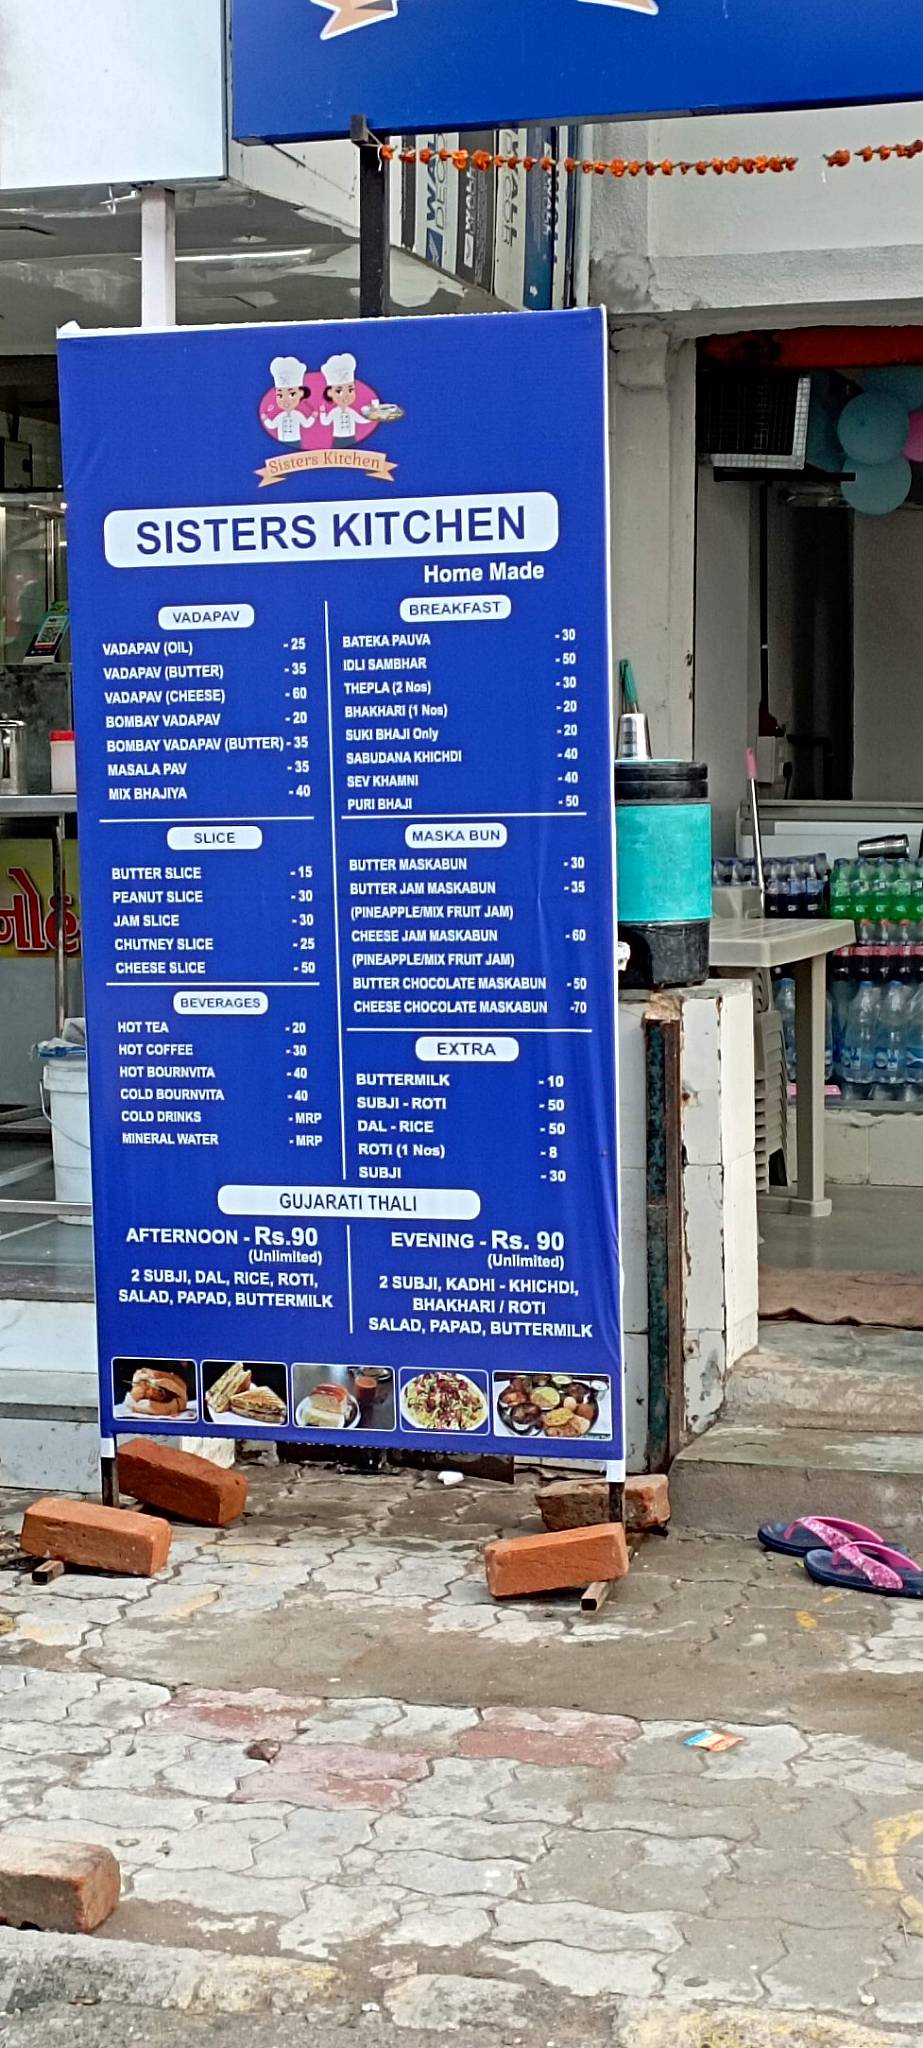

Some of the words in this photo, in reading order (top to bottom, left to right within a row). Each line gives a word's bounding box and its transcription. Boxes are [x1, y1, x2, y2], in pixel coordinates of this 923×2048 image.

[268, 455, 318, 474] Sisters
[324, 451, 380, 470] Kitchen
[137, 515, 316, 554] SISTERS
[333, 506, 524, 547] KITCHEN
[424, 565, 483, 583] Home
[490, 561, 544, 580] Made
[410, 602, 501, 615] BREAKFAST
[173, 611, 239, 623] VADAPAV
[343, 635, 390, 648] BATEKA
[392, 634, 430, 646] PAUVA
[102, 642, 160, 655] VADAPAV
[164, 641, 192, 656] (OIL)
[344, 659, 365, 671] IDLI
[368, 657, 426, 670] SAMBHAR
[104, 666, 161, 680] VADAPAV
[165, 665, 223, 680] (BUTTER)
[344, 682, 390, 694] THEPLA
[392, 682, 402, 695] (2
[406, 681, 431, 694] Nos)
[104, 691, 162, 704] VADAPAV
[166, 689, 225, 705] (CHEESE)
[345, 705, 406, 718] BHAKHARI
[408, 704, 418, 719] (1
[422, 704, 447, 718] Nos)
[106, 715, 159, 728] BOMBAY
[162, 714, 220, 726] VADAPAV
[346, 729, 373, 740] SUKI
[376, 728, 410, 740] BHAJI
[413, 728, 438, 742] Only
[107, 740, 160, 752] BOMBAY
[163, 738, 221, 751] VADAPAV
[225, 736, 284, 752] (BUTTER)
[346, 752, 411, 764] SABUDANA
[414, 750, 461, 762] KHICHDI
[108, 764, 161, 776] MASALA
[164, 763, 187, 775] PAV
[347, 776, 371, 787] SEV
[373, 775, 418, 786] KHAMNI
[109, 788, 130, 800] MIX
[134, 787, 187, 800] BHAJIYA
[348, 798, 374, 810] PURI
[378, 798, 412, 810] BHAJI
[194, 832, 236, 844] SLICE
[413, 830, 464, 841] MASKA
[470, 830, 500, 840] BUN
[350, 859, 396, 871] BUTTER
[399, 858, 466, 870] MASKABUN
[112, 868, 162, 880] BUTTER
[165, 867, 201, 879] SLICE
[350, 883, 397, 894] BUTTER
[400, 882, 424, 894] JAM
[428, 882, 495, 894] MASKABUN
[113, 891, 163, 903] PEANUT
[167, 891, 203, 902] SLICE
[351, 906, 444, 920] (PINEAPPLE/MIX
[447, 906, 481, 917] FRUIT
[484, 906, 513, 920] JAM)
[114, 915, 139, 926] JAM
[143, 915, 179, 926] SLICE
[352, 930, 399, 942] CHEESE
[402, 930, 426, 942] JAM
[430, 930, 497, 942] MASKABUN
[115, 938, 174, 950] CHUTNEY
[177, 938, 213, 950] SLICE
[352, 954, 445, 968] (PINEAPPLE/MIX
[448, 954, 483, 965] FRUIT
[486, 954, 514, 968] JAM)
[116, 962, 166, 974] CHEESE
[170, 962, 205, 973] SLICE
[353, 978, 400, 989] BUTTER
[403, 978, 476, 989] CHOCOLATE
[478, 977, 546, 989] MASKABUN
[181, 998, 260, 1008] BEVERAGES
[354, 1001, 401, 1012] CHEESE
[404, 1001, 476, 1013] CHOCOLATE
[480, 1001, 547, 1013] MASKABUN
[118, 1022, 142, 1032] HOT
[145, 1022, 169, 1032] TEA
[119, 1044, 143, 1055] HOT
[146, 1044, 193, 1055] COFFEE
[438, 1042, 496, 1055] EXTRA
[120, 1066, 144, 1077] HOT
[147, 1066, 215, 1078] BOURNVITA
[356, 1074, 450, 1086] BUTTERMILK
[121, 1088, 153, 1099] COLD
[156, 1089, 224, 1100] BOURNVITA
[357, 1097, 399, 1109] SUBJI
[412, 1098, 446, 1109] ROTI
[122, 1111, 154, 1122] COLD
[157, 1111, 201, 1122] DRINKS
[358, 1120, 387, 1132] DAL
[400, 1121, 434, 1132] RICE
[122, 1132, 175, 1144] MINERAL
[177, 1134, 218, 1144] WATER
[359, 1143, 392, 1155] ROTI
[396, 1144, 408, 1158] (1
[413, 1144, 445, 1158] Nos)
[359, 1166, 401, 1178] SUBJI
[280, 1193, 362, 1210] GUJARATI
[368, 1195, 416, 1211] THALI
[126, 1228, 238, 1244] AFTERNOON
[255, 1226, 318, 1246] Rs.90
[392, 1232, 474, 1248] EVENING
[492, 1230, 529, 1250] Rs.
[537, 1232, 564, 1250] 90
[249, 1249, 322, 1266] (Unlimited)
[488, 1254, 564, 1271] (Unlimited)
[132, 1269, 140, 1282] 2
[144, 1269, 191, 1284] SUBJI,
[196, 1270, 230, 1286] DAL,
[234, 1272, 273, 1287] RICE,
[278, 1273, 318, 1288] ROTI,
[380, 1276, 388, 1288] 2
[392, 1276, 441, 1292] SUBJI,
[446, 1278, 495, 1291] KADHI
[509, 1279, 578, 1296] KHICHDI,
[119, 1289, 173, 1305] SALAD,
[178, 1291, 231, 1306] PAPAD,
[236, 1292, 333, 1308] BUTTERMILK
[413, 1298, 495, 1312] BHAKHARI
[508, 1300, 545, 1314] ROTI
[369, 1318, 425, 1334] SALAD,
[430, 1320, 486, 1336] PAPAD,
[491, 1322, 592, 1337] BUTTERMILK
